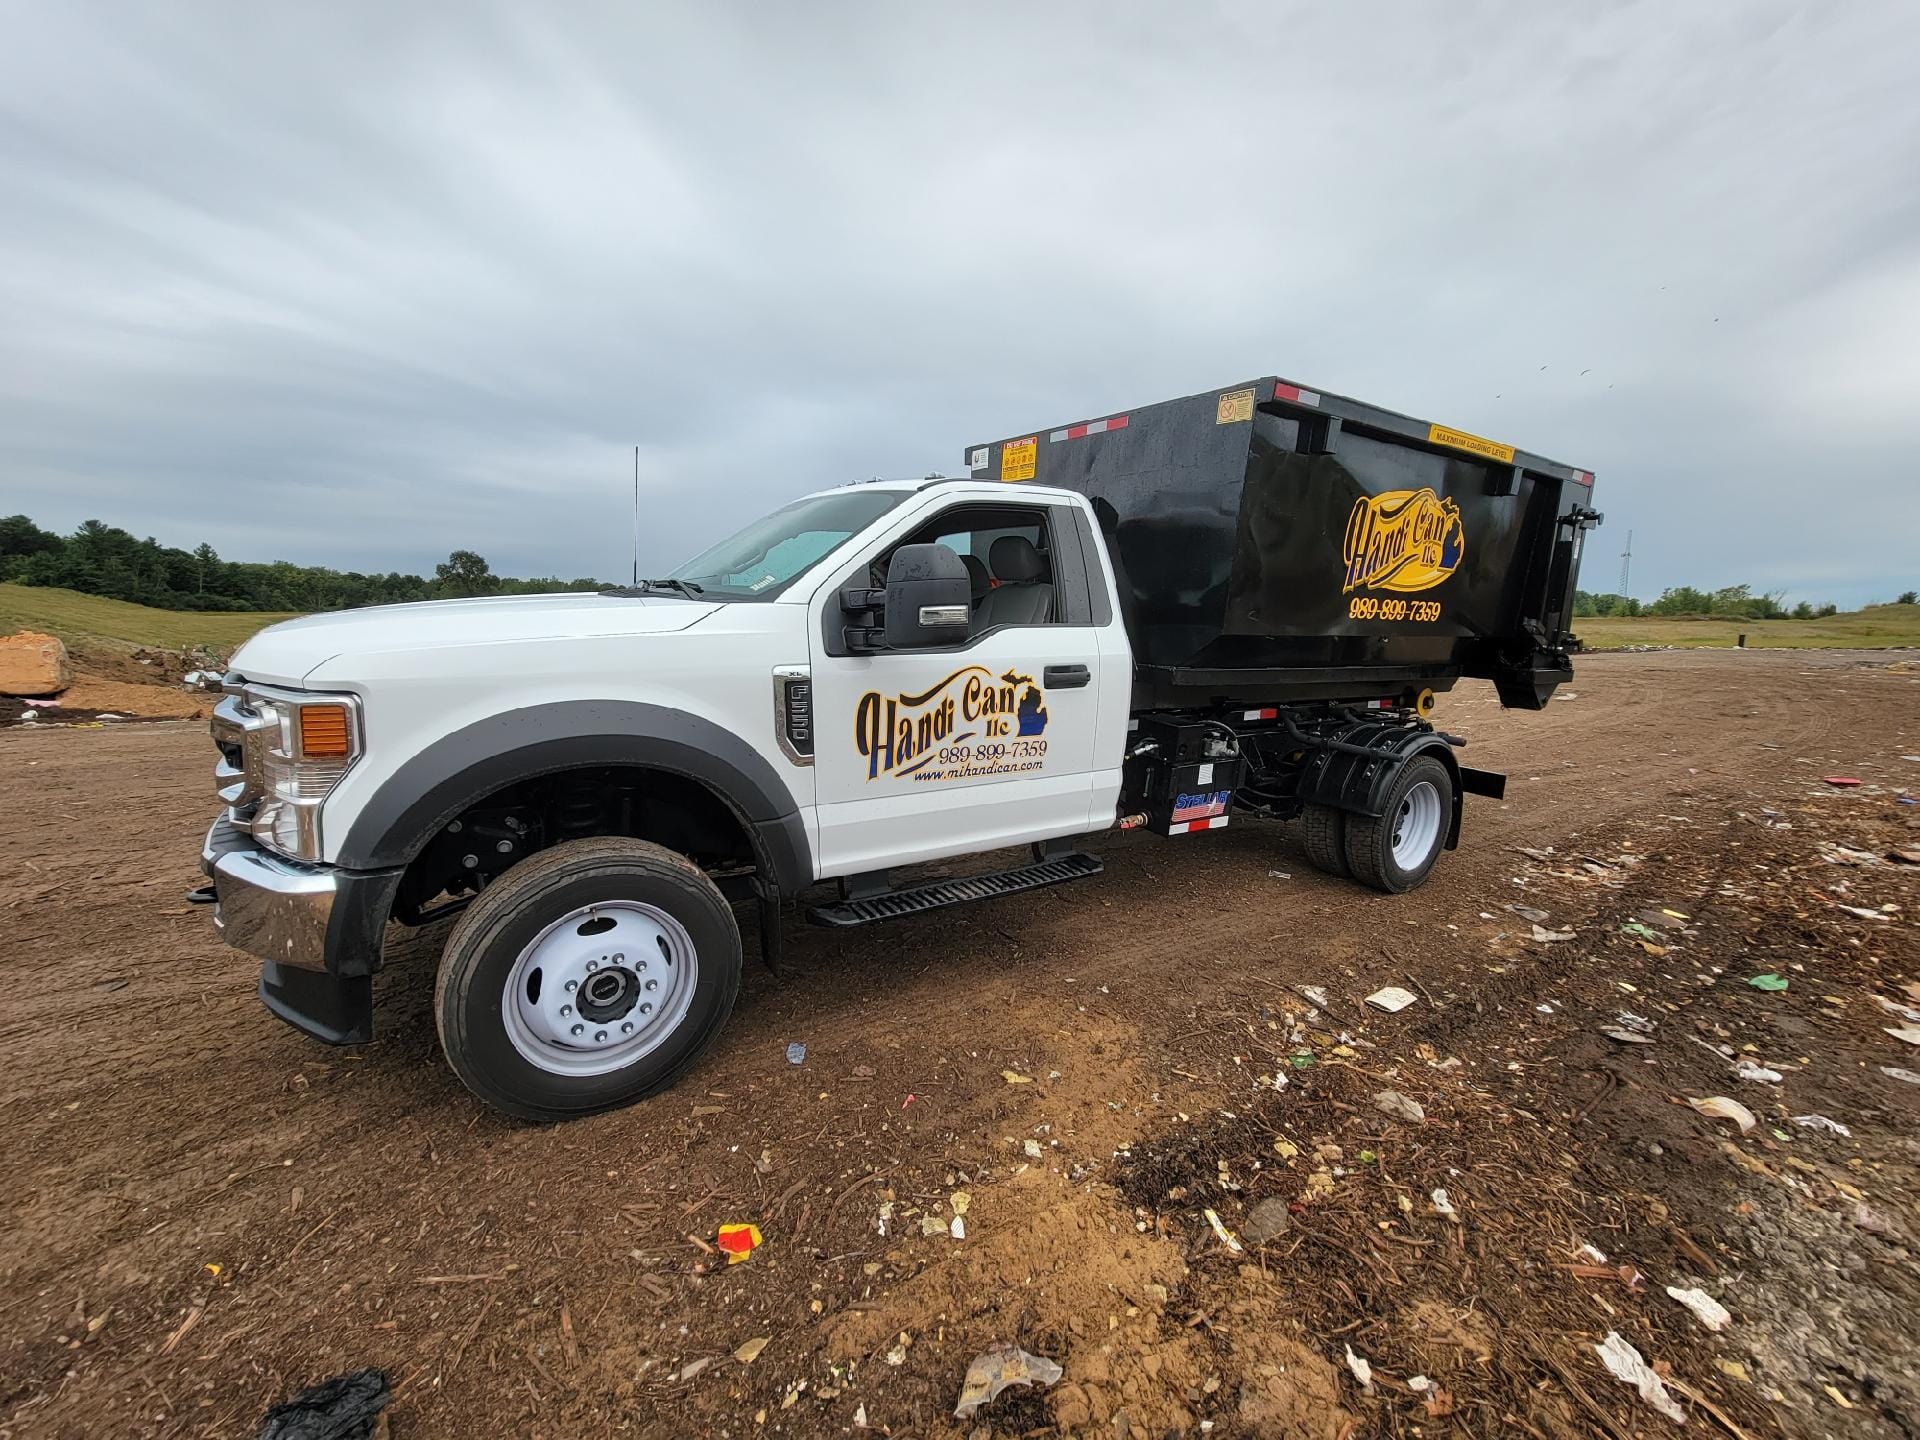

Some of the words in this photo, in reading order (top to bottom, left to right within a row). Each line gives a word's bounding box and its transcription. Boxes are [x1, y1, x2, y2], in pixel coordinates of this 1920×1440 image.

[1436, 432, 1465, 447] MAXIMUM
[1466, 441, 1491, 454] LOADING
[1491, 447, 1507, 459] LEVEL
[1344, 497, 1410, 588] Handi
[1413, 498, 1445, 544] Can
[1349, 597, 1441, 622] 989-899-7359
[856, 692, 954, 780] Handi
[963, 675, 1015, 722] Can
[939, 740, 1048, 765] 989-899-7359
[914, 759, 1043, 782] www.mihandican.com
[1175, 791, 1228, 809] STELLAR
